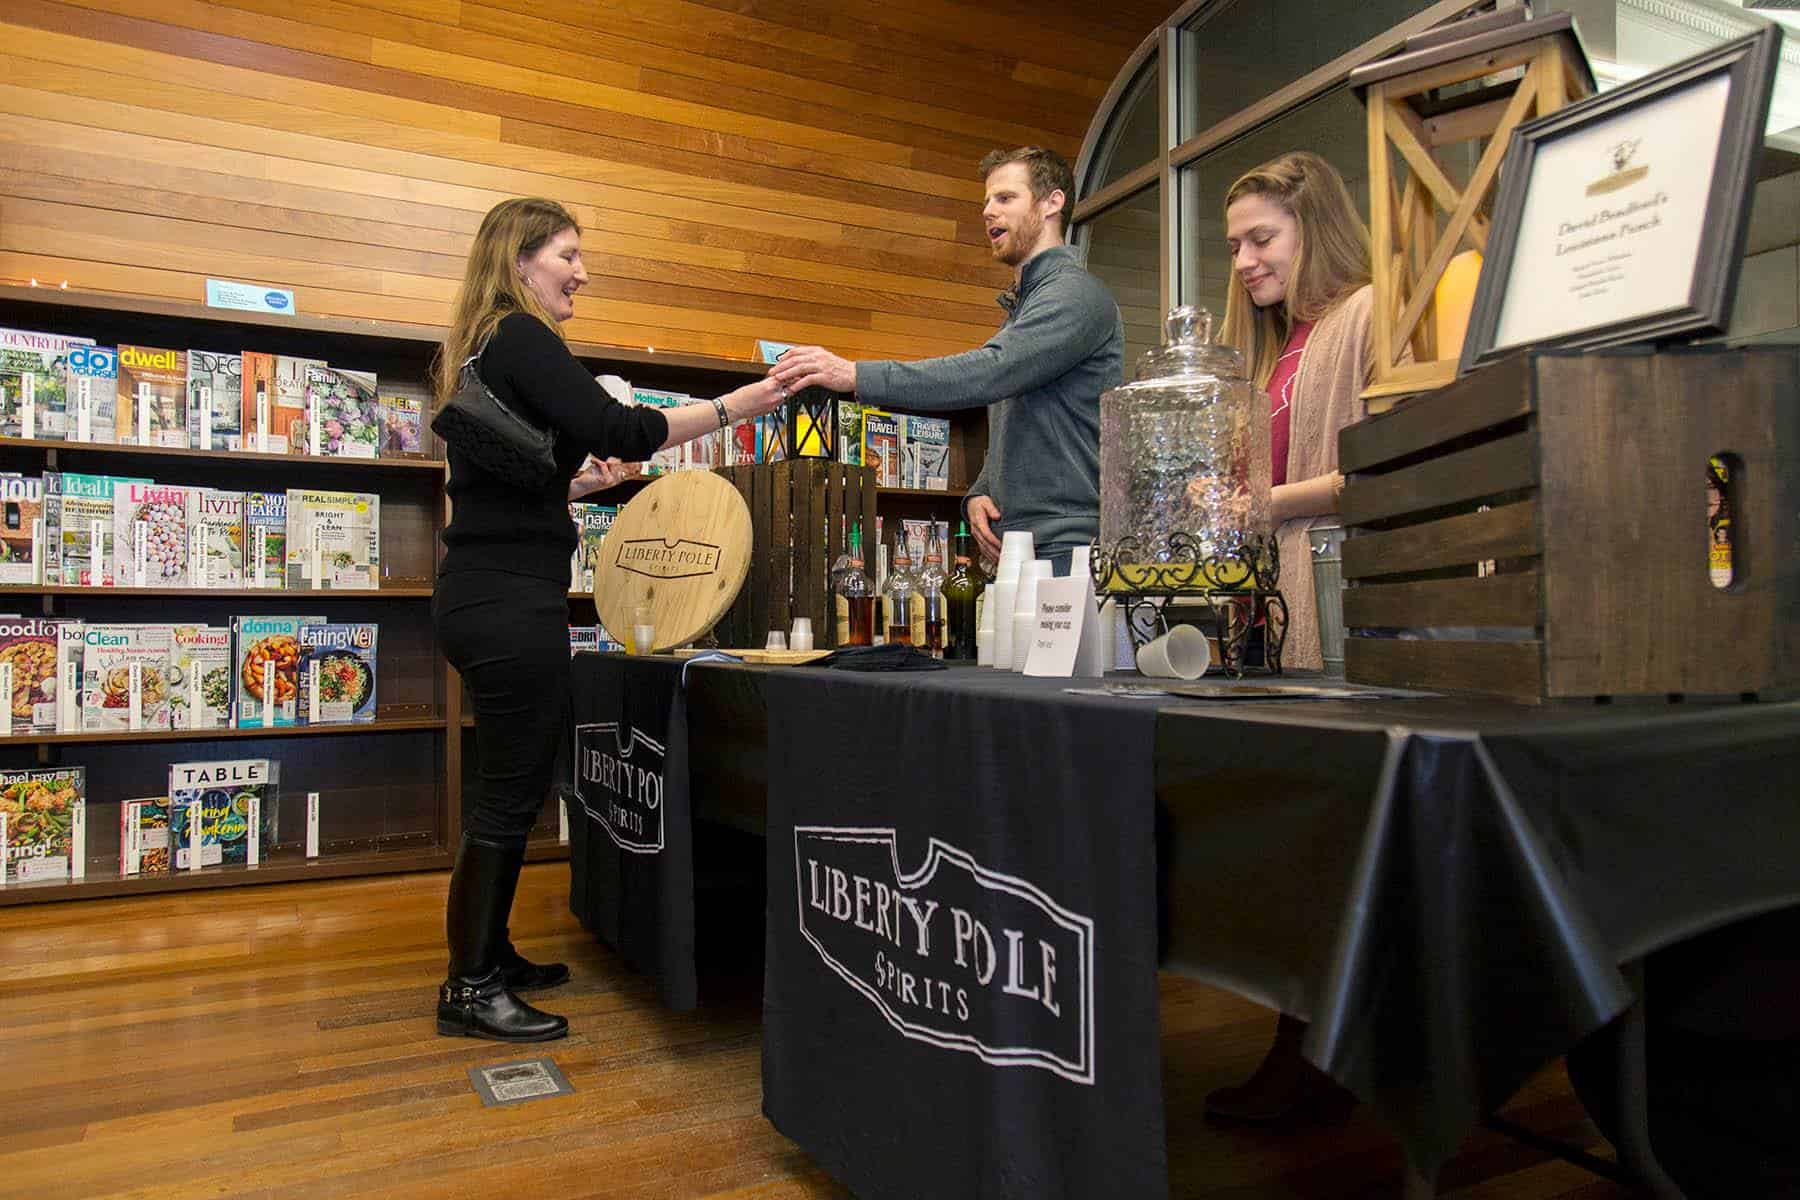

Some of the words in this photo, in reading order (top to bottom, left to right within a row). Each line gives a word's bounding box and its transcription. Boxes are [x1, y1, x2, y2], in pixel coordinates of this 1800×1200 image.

[120, 346, 177, 370] dwell
[66, 477, 104, 496] Ideal
[302, 494, 326, 503] REAL
[314, 511, 345, 519] BRIGHT
[624, 547, 676, 563] LIBERTY
[678, 549, 712, 566] POLE
[243, 619, 292, 633] donna
[86, 631, 129, 646] Clean
[183, 765, 259, 784] TABLE
[582, 745, 635, 799] LIBERTY
[808, 858, 939, 957] LIBERTY
[949, 906, 1061, 1018] POLE
[874, 951, 970, 1022] SPIRITS
